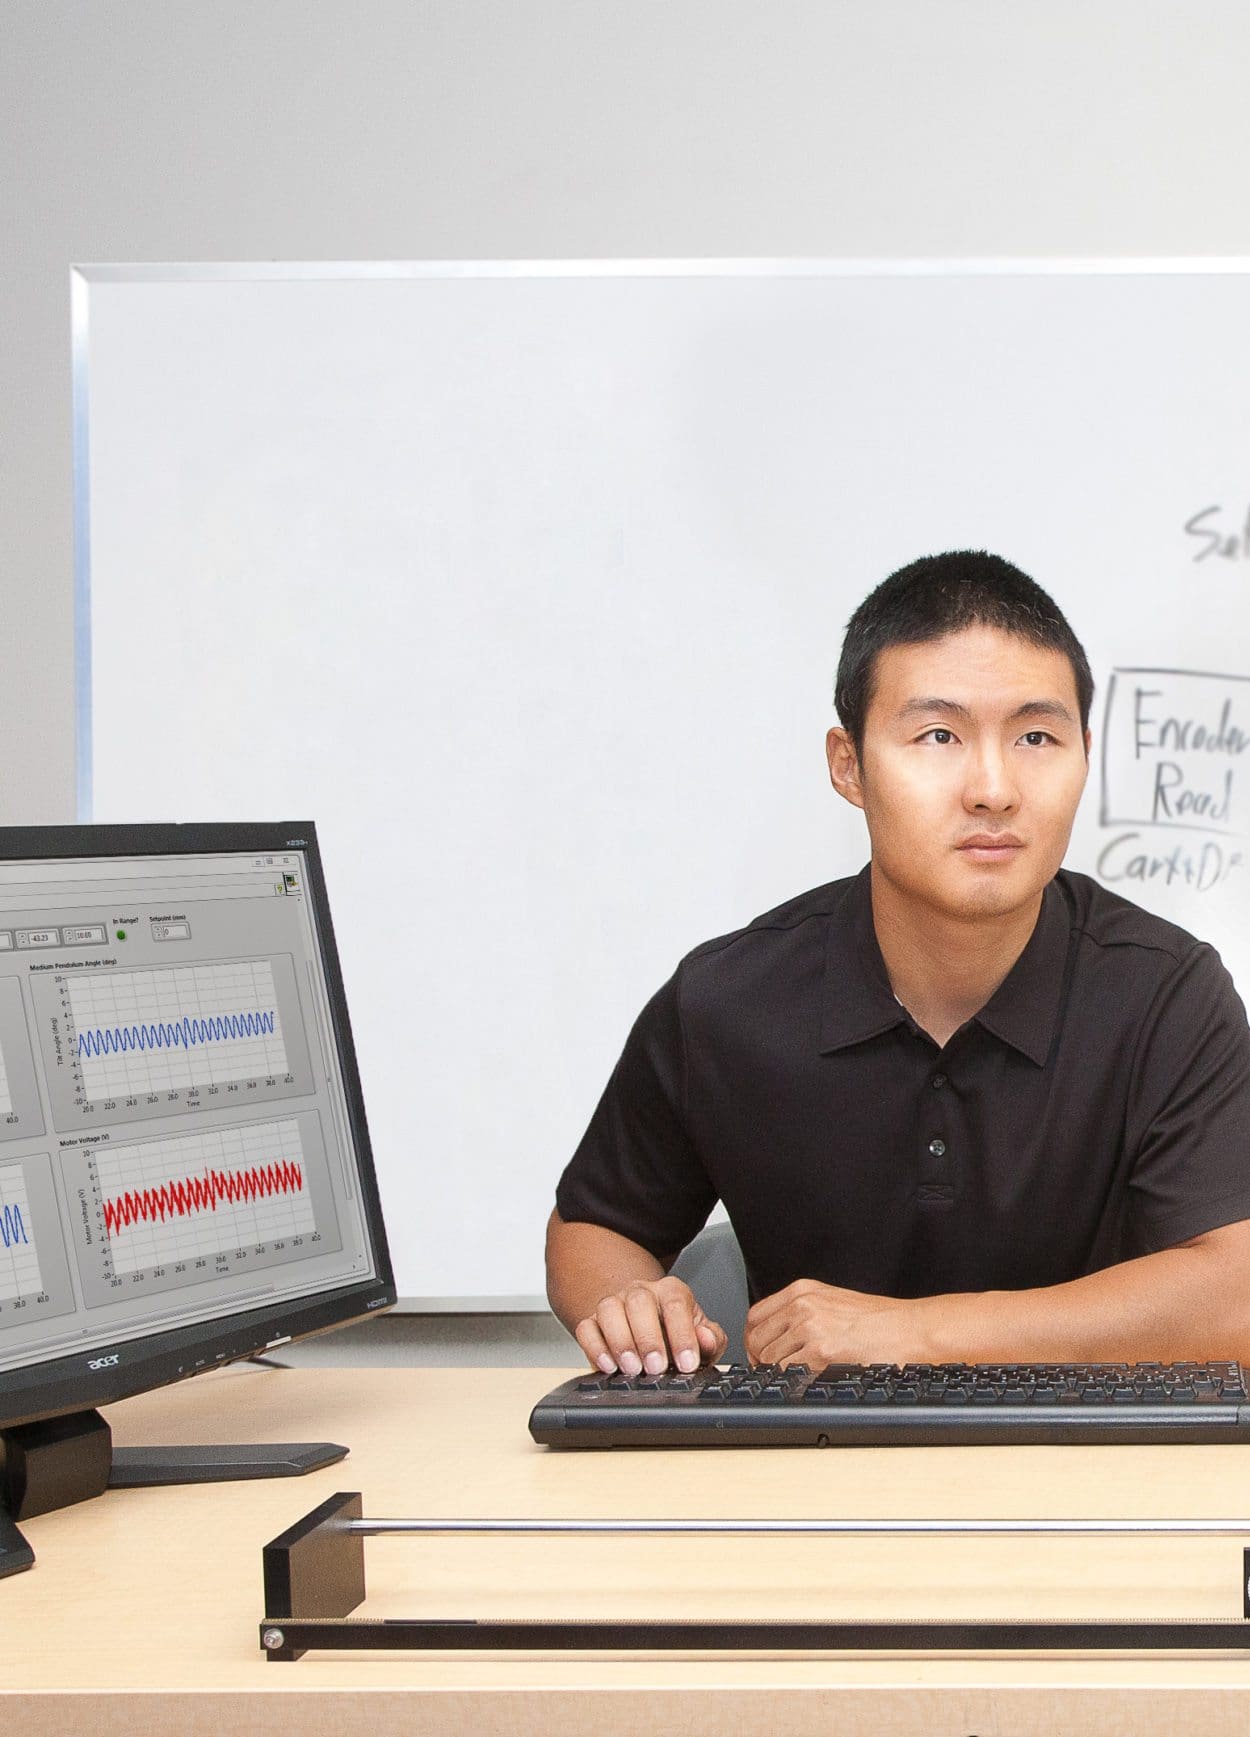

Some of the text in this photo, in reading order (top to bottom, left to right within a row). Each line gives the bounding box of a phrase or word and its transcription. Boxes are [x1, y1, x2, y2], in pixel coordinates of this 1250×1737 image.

[1150, 761, 1232, 823] Read
[29, 963, 54, 971] Medium
[85, 959, 101, 967] Angle
[102, 958, 118, 967] (deg)
[59, 1138, 78, 1147] Motor
[78, 1135, 100, 1144] Voltage
[133, 1274, 144, 1282] 22.0
[87, 1353, 120, 1371] acer
